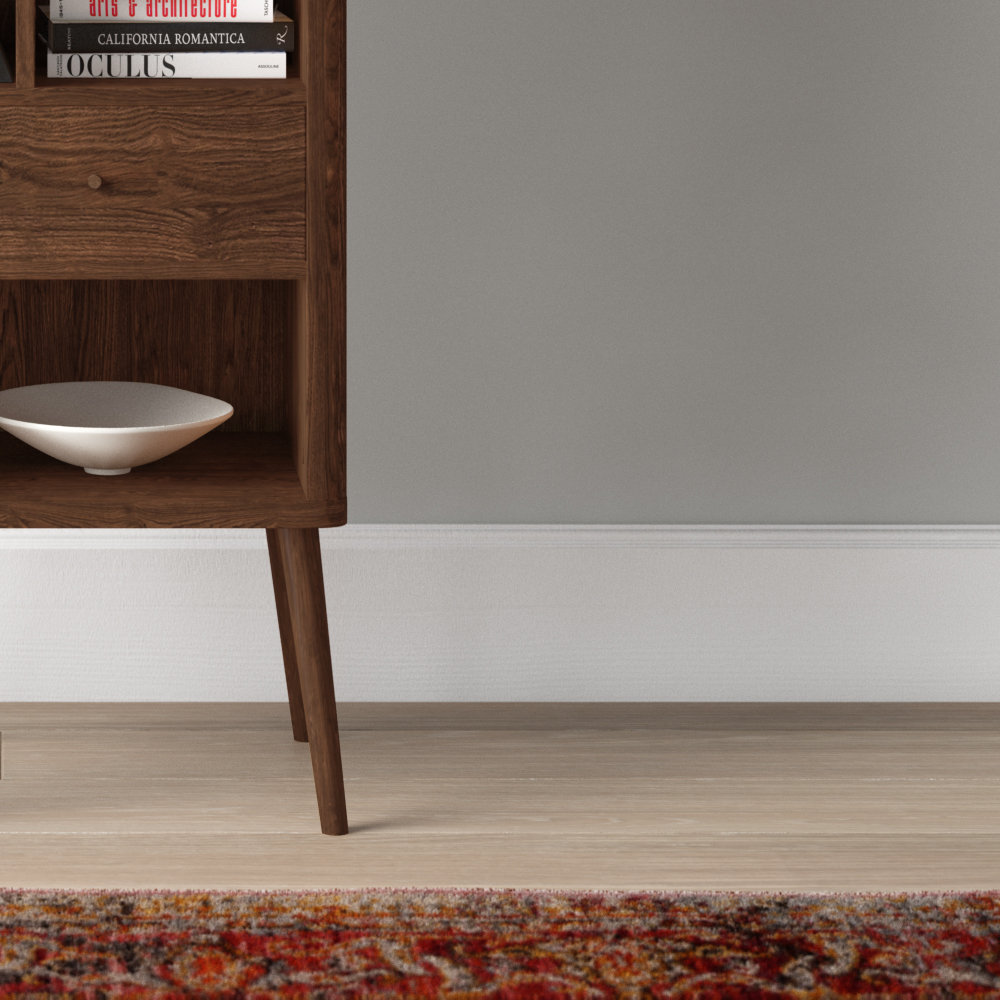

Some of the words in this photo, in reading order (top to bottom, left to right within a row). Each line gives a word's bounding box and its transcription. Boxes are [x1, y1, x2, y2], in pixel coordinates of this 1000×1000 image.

[97, 33, 171, 46] CALIFORNIA
[174, 32, 246, 45] ROMANTICA
[66, 53, 176, 78] OCULUS
